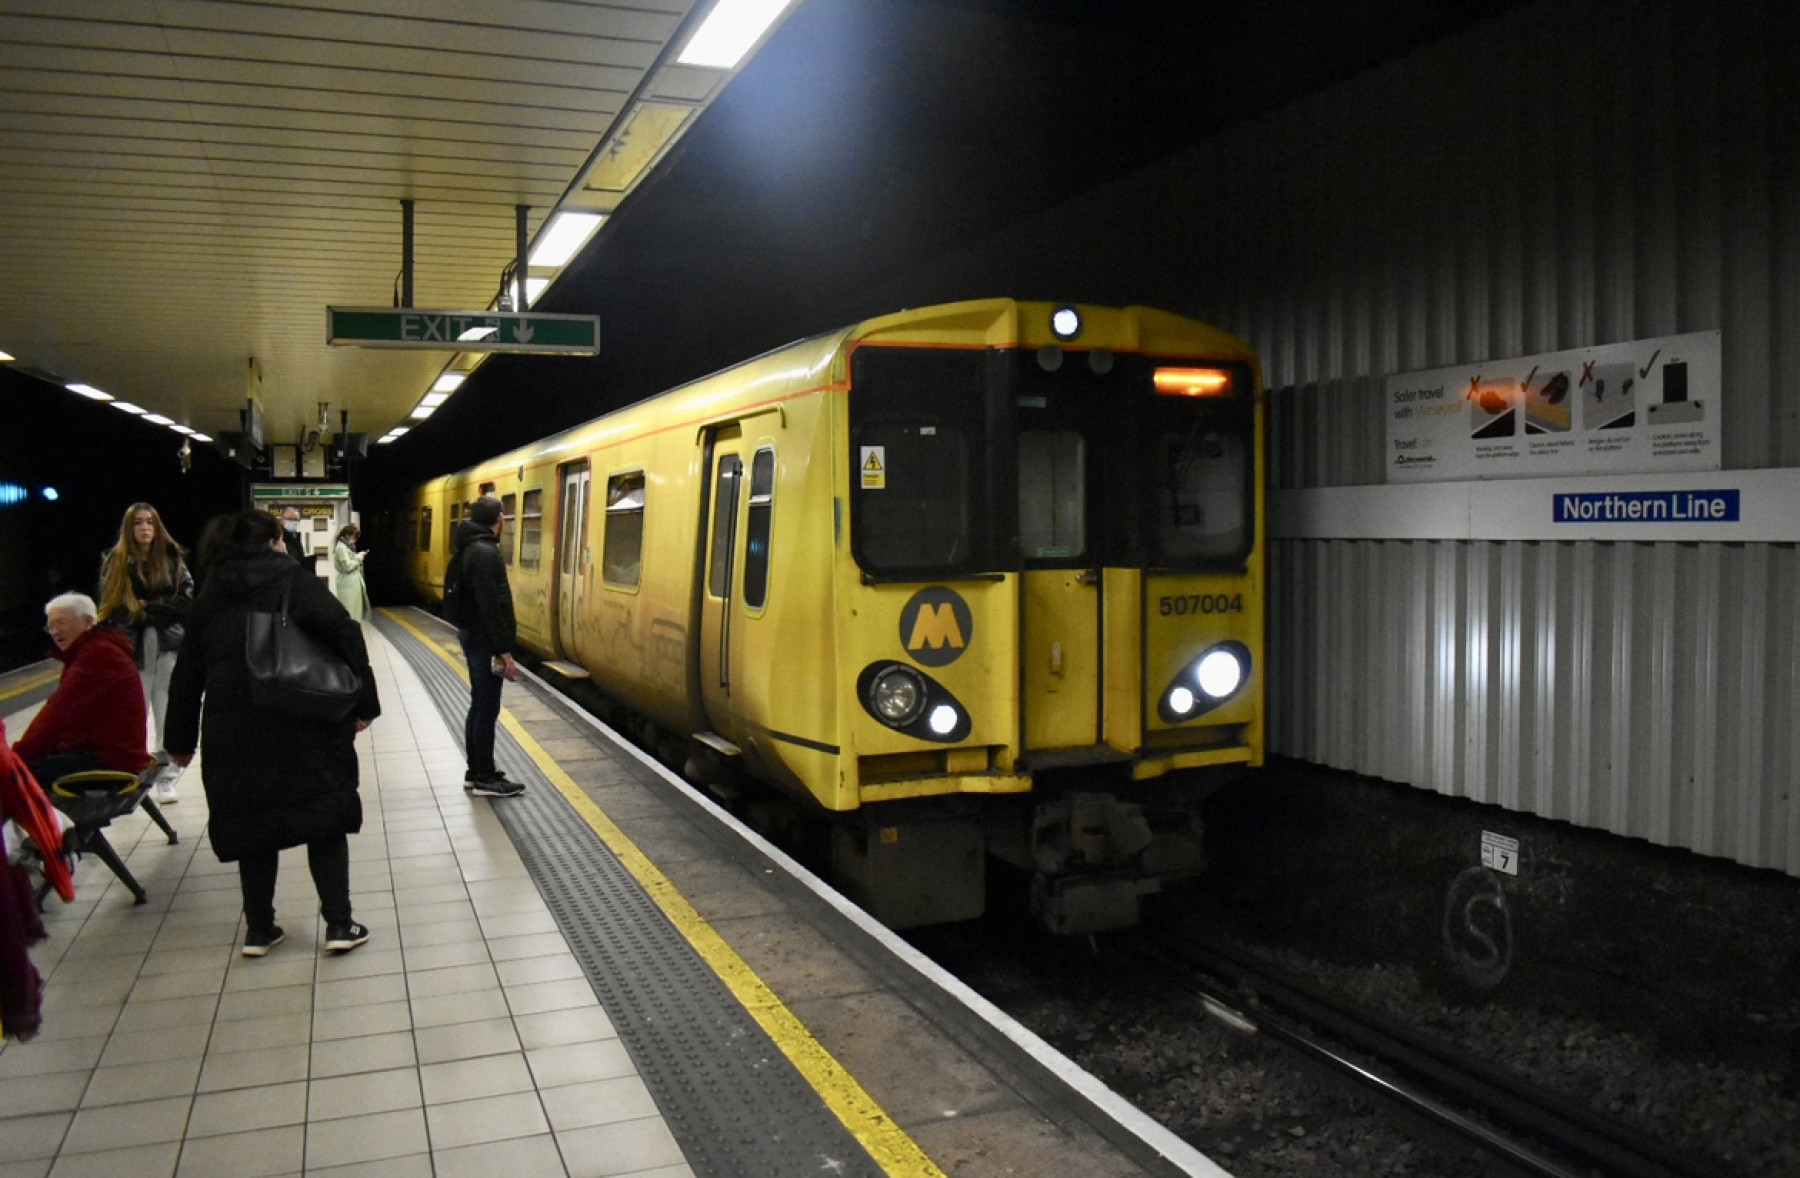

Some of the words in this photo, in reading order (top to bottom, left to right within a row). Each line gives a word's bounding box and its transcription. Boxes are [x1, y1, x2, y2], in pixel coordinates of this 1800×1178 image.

[400, 314, 473, 342] EXIT
[1394, 389, 1417, 403] Safer
[1418, 384, 1444, 400] travel
[1393, 405, 1413, 419] with
[1563, 495, 1667, 519] Northern
[1672, 494, 1726, 518] Line
[1160, 593, 1243, 616] 507004
[1501, 854, 1509, 869] 7
